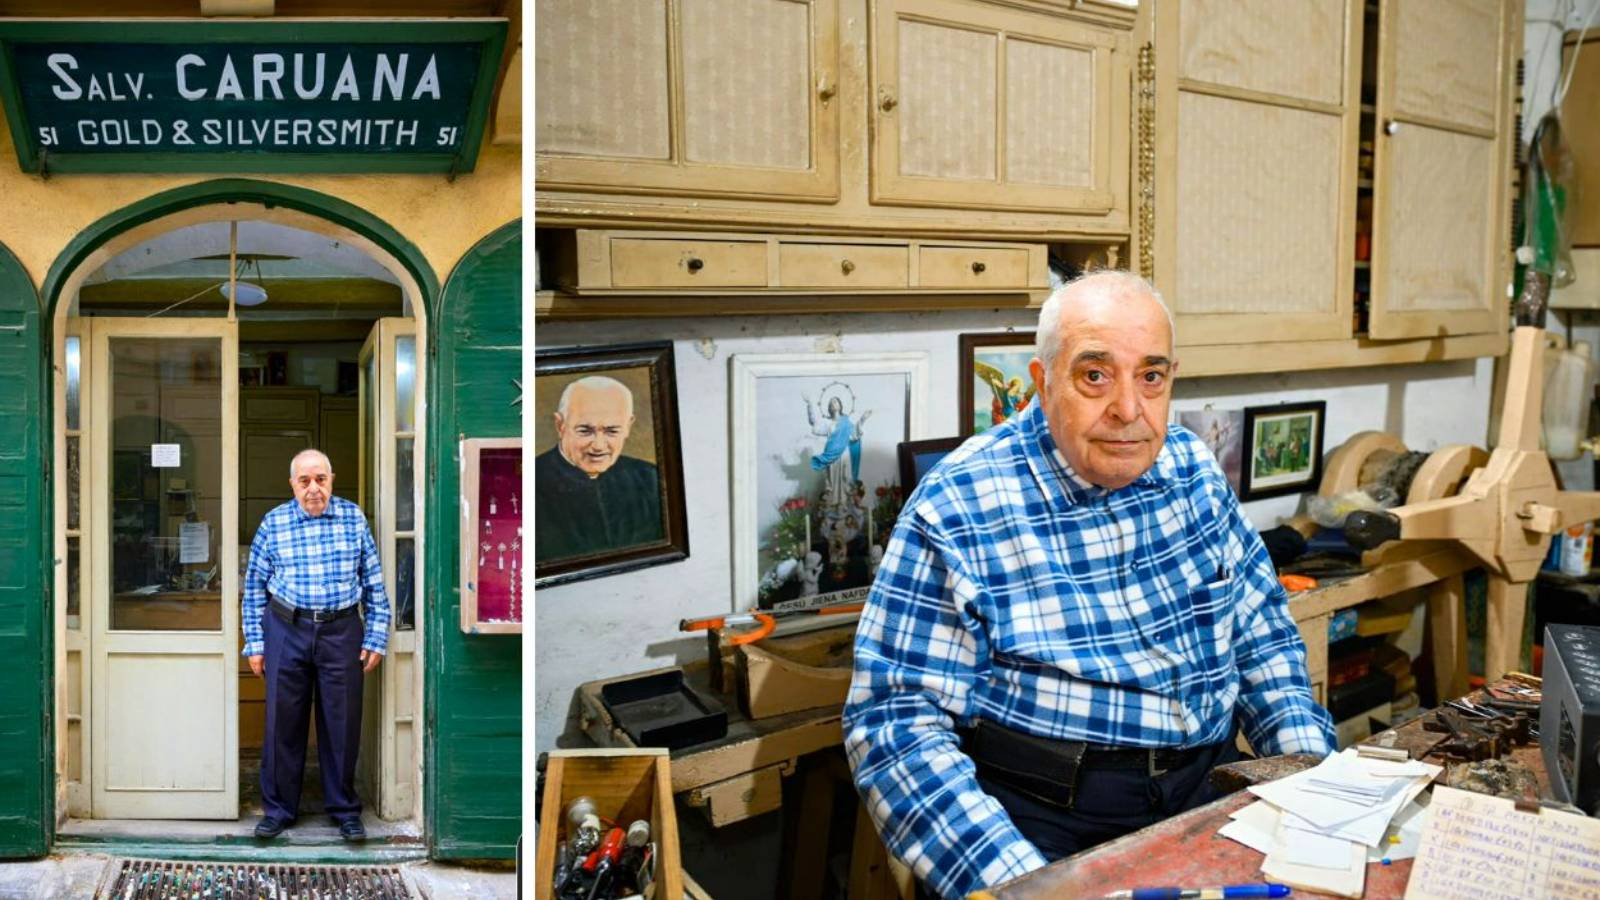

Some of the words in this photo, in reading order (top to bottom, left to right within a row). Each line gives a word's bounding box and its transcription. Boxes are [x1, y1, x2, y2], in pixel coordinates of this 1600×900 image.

[176, 53, 441, 101] CARUANA
[39, 126, 59, 145] 51
[77, 119, 162, 145] GOLD
[172, 119, 195, 145] &
[202, 119, 418, 145] SILVERSMITH
[436, 127, 457, 146] 51
